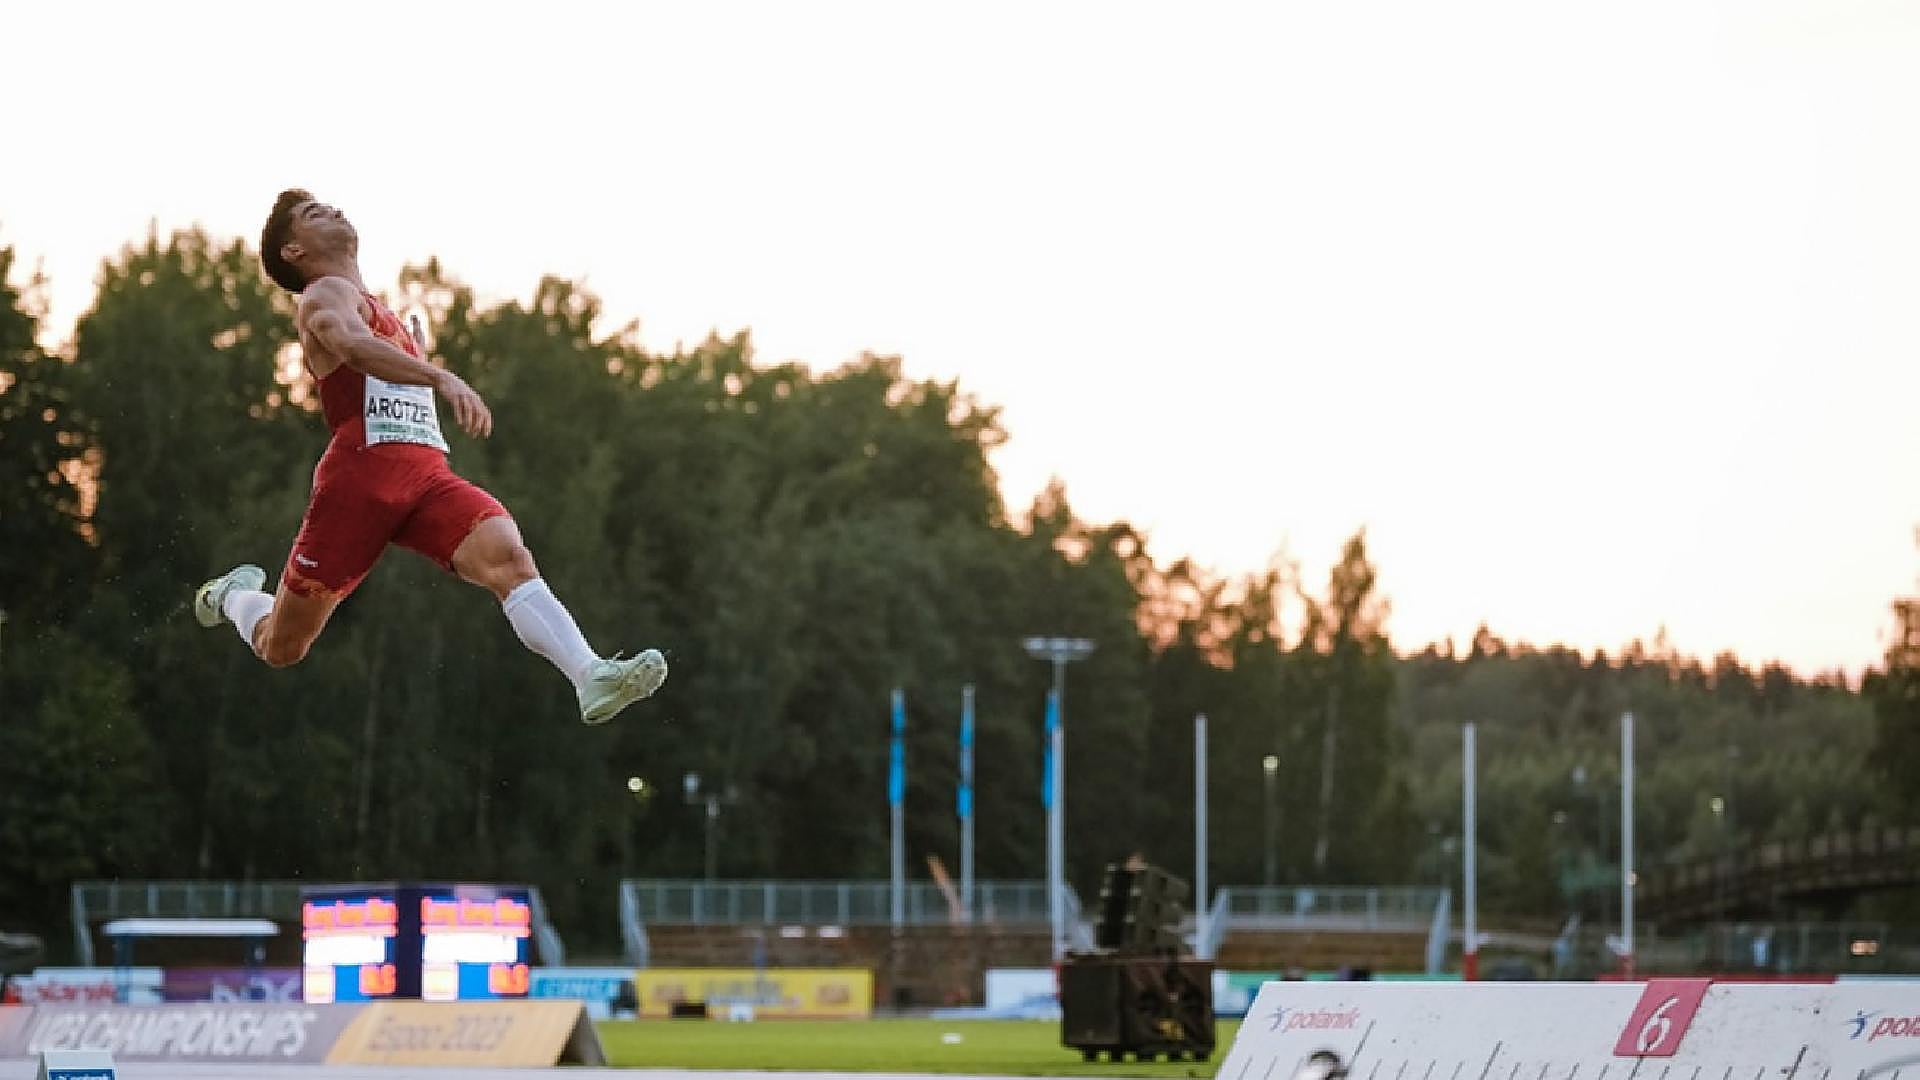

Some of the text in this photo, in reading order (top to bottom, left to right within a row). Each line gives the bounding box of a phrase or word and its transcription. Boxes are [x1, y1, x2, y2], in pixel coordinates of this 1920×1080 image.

[74, 1011, 318, 1055] CHAMPIONSHIPS
[1281, 1007, 1360, 1033] polanik
[1637, 998, 1679, 1052] 6
